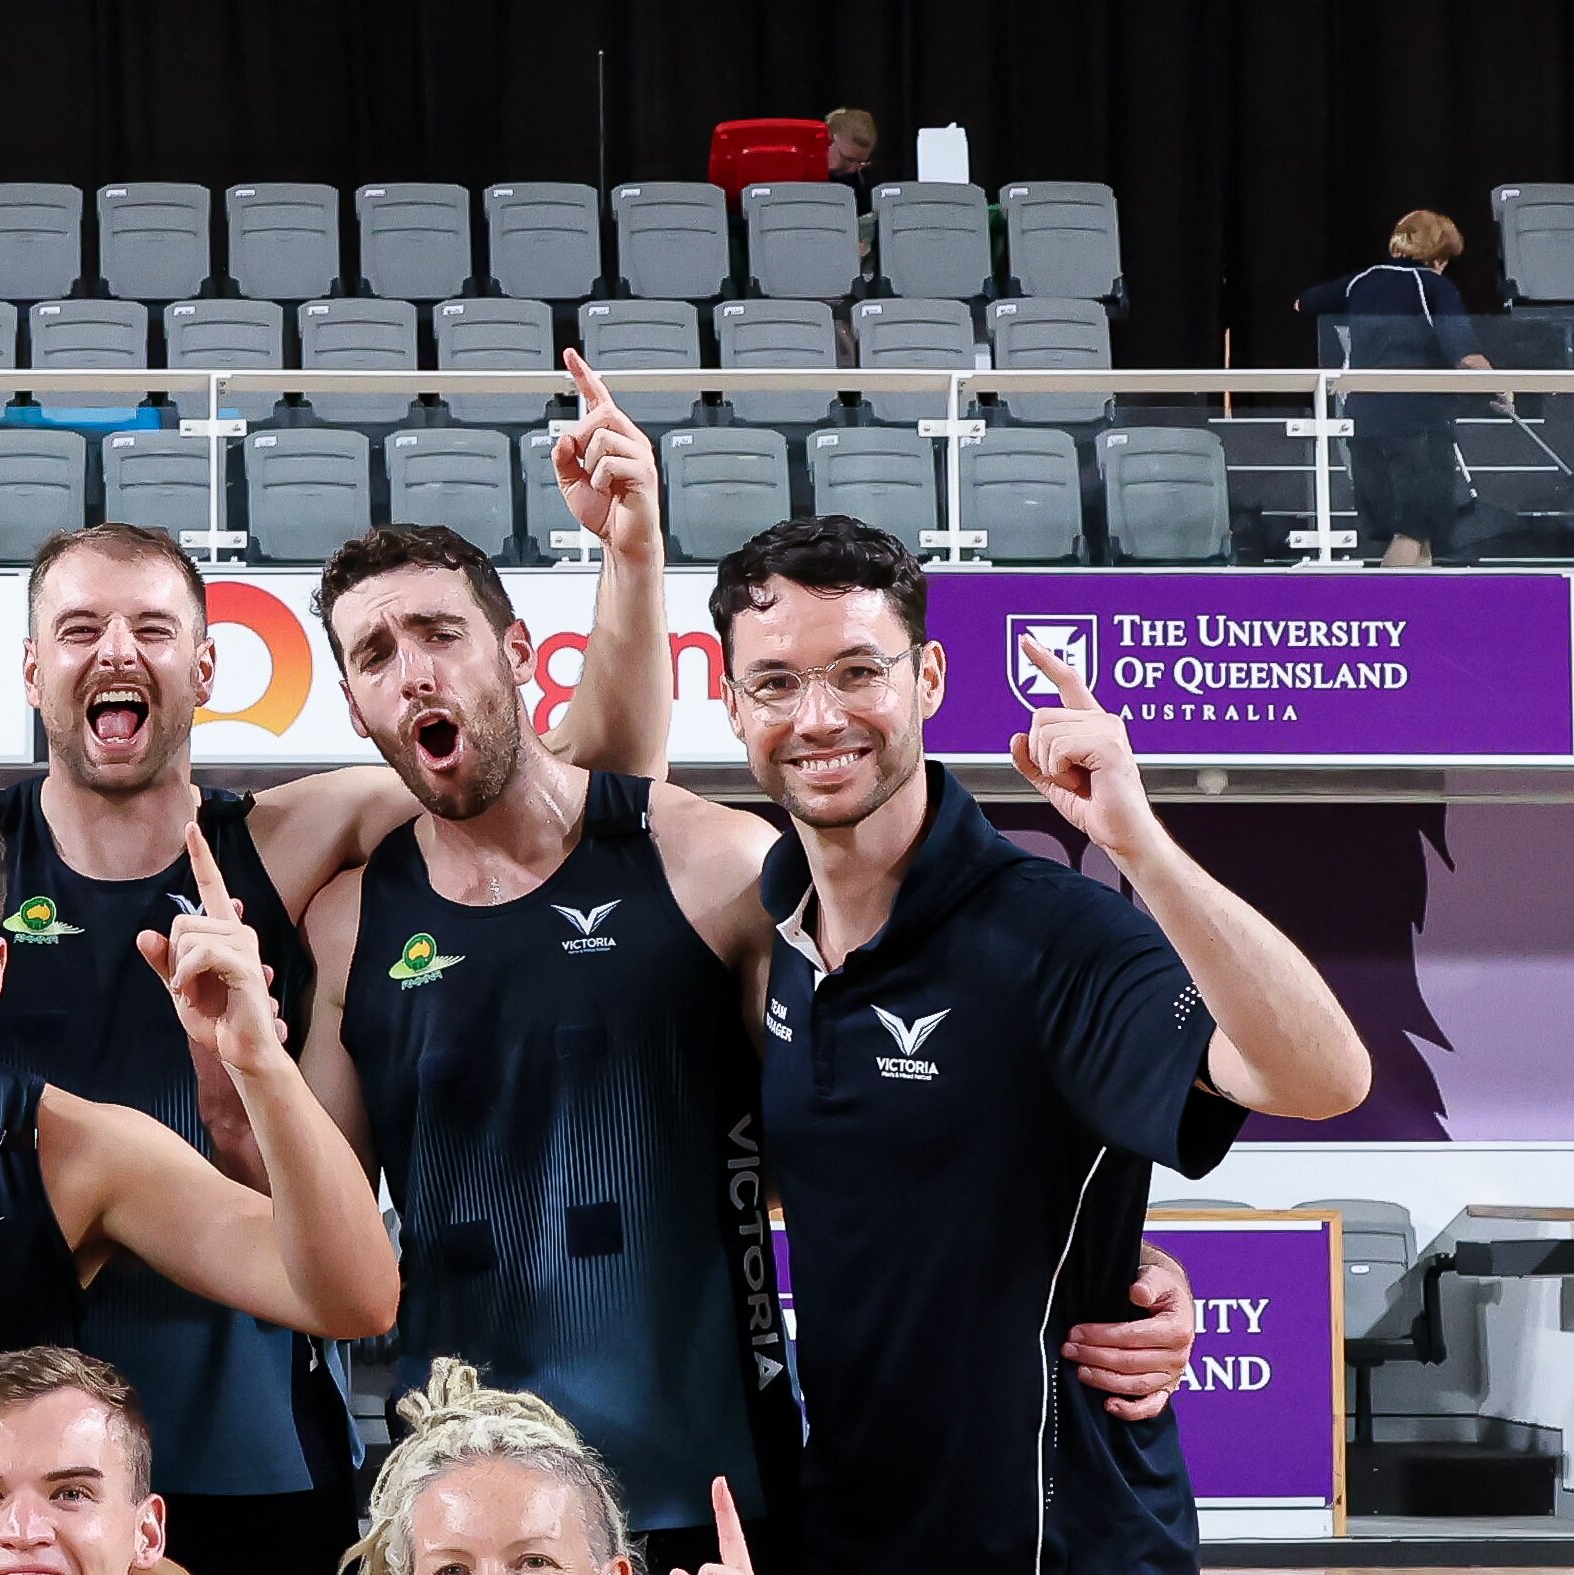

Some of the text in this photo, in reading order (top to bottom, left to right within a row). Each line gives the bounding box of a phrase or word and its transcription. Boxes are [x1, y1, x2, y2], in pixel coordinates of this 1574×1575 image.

[1113, 614, 1407, 648] THE UNIVERSITY
[1114, 660, 1408, 695] OF QUEENSLAND
[1119, 704, 1299, 722] AUSTRALIA
[561, 937, 617, 950] VICTORIA
[876, 1056, 939, 1075] VICTORIA
[728, 1112, 784, 1391] VICTORIA
